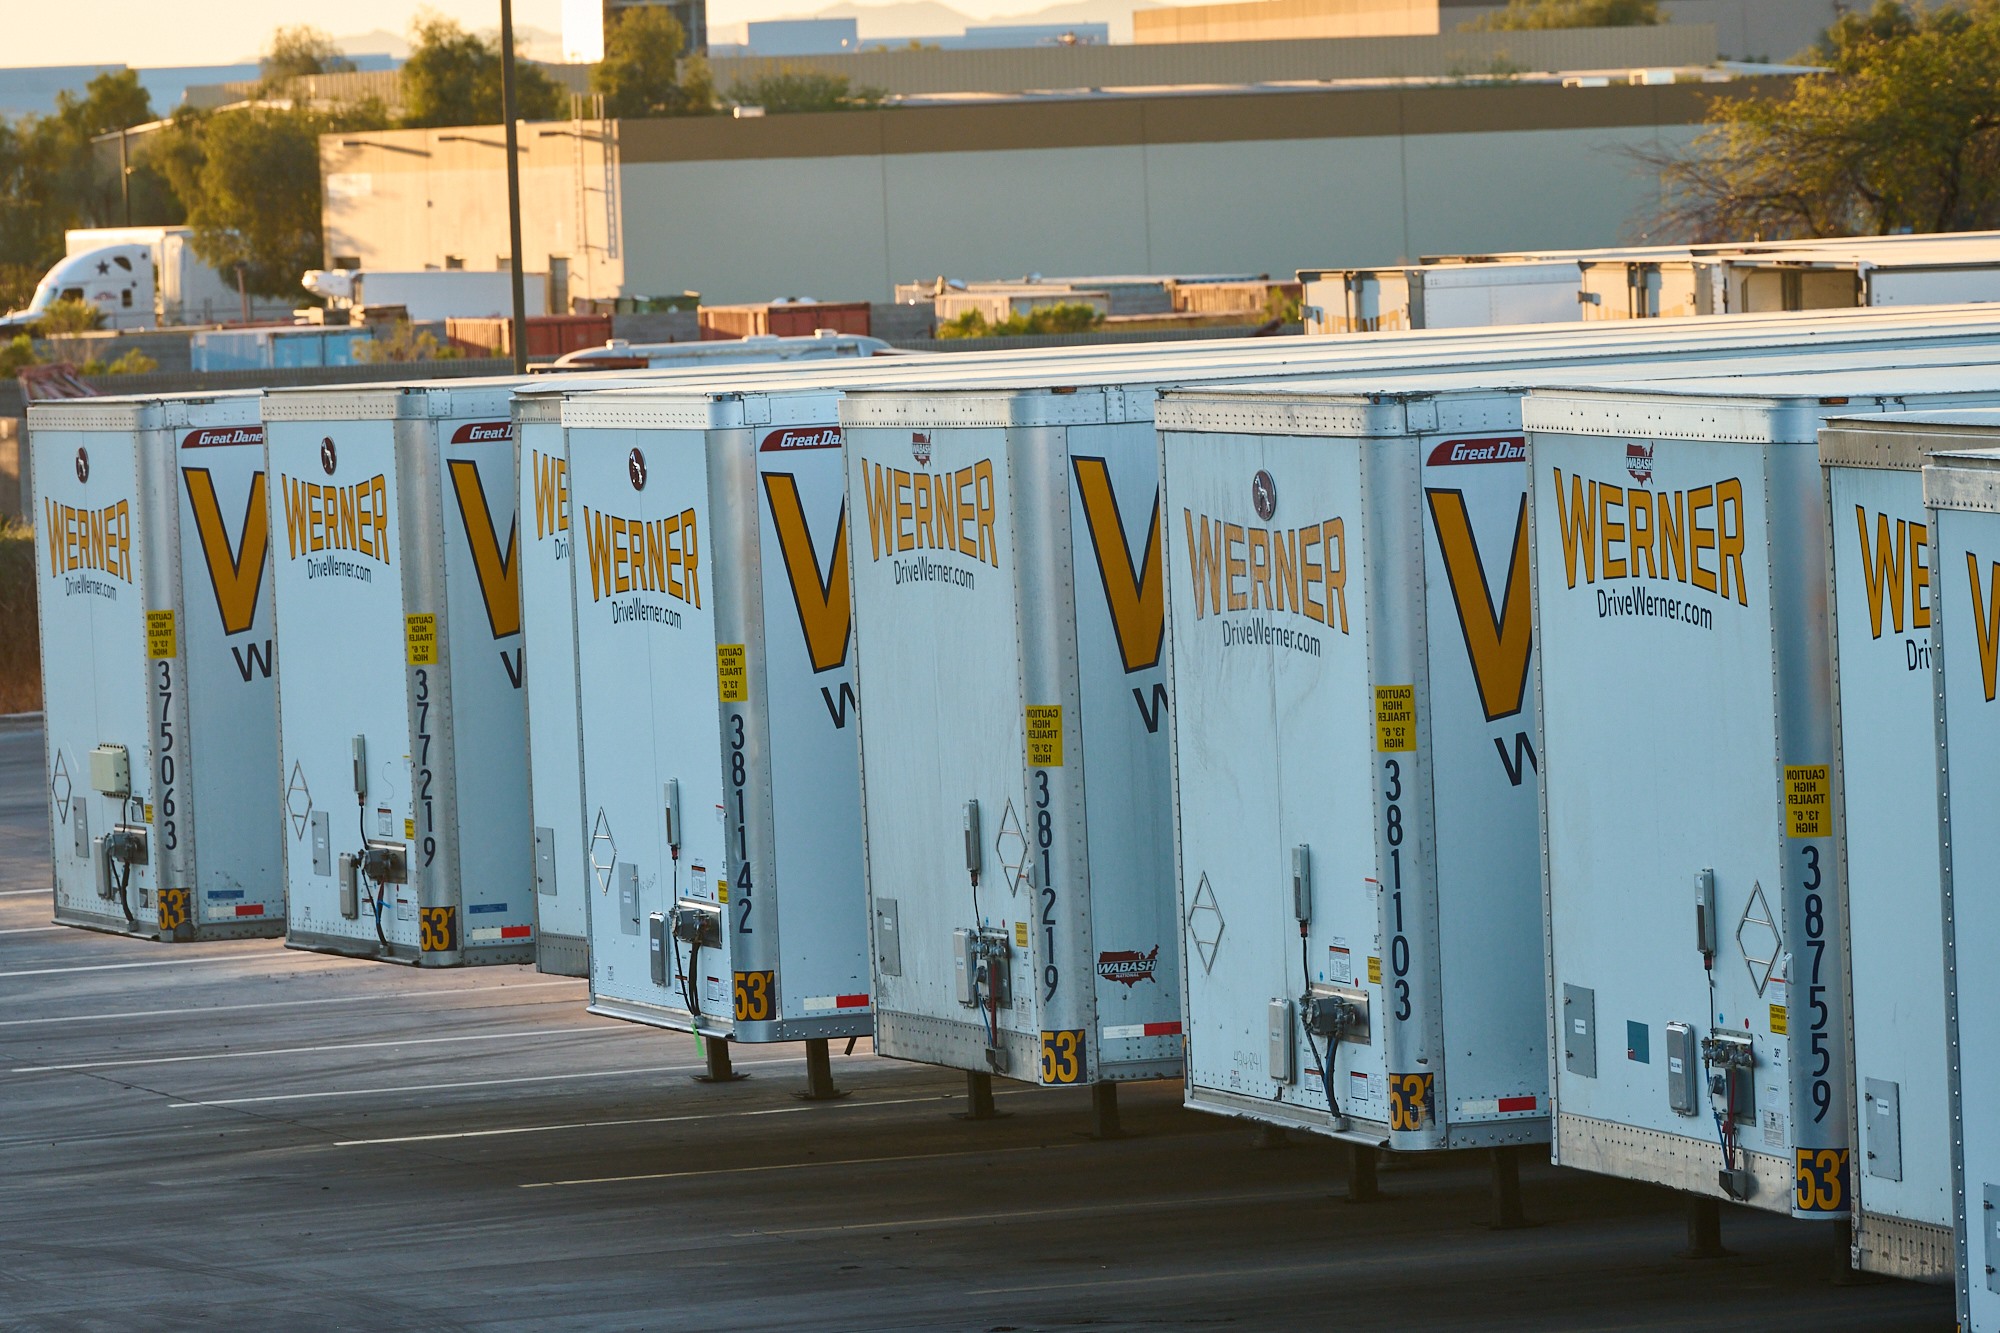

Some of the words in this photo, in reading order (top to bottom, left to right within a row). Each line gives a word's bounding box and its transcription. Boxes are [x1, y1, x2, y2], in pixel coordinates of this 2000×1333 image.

[199, 432, 232, 445] Great
[232, 430, 263, 443] Dane
[469, 426, 504, 439] Great
[780, 432, 820, 447] Great
[1450, 443, 1496, 461] Great
[1626, 457, 1653, 470] WABASH
[281, 473, 390, 565] WERNER
[861, 457, 998, 568] WERNER
[1553, 466, 1748, 607] WERNER
[45, 496, 132, 584] WERNER
[583, 505, 701, 610] WERNER
[65, 574, 117, 601] DriveWerner.com
[307, 555, 372, 583] DriveWerner.com
[894, 556, 974, 590] DriveWerner.com
[1183, 507, 1349, 635] WERNER
[611, 598, 682, 630] DriveWerner.com
[1597, 586, 1712, 631] DriveWerner.com
[1222, 618, 1321, 658] DriveWerner.com
[157, 660, 177, 851] 375063
[415, 668, 436, 868] 377219
[730, 714, 753, 934] 381142
[1034, 770, 1059, 1001] 381219
[1384, 759, 1411, 1021] 381103
[1098, 960, 1156, 974] WABASH
[1801, 845, 1831, 1123] 387559
[735, 972, 774, 1020] 53'
[1042, 1031, 1084, 1083] 53'
[1797, 1149, 1848, 1210] 53'
